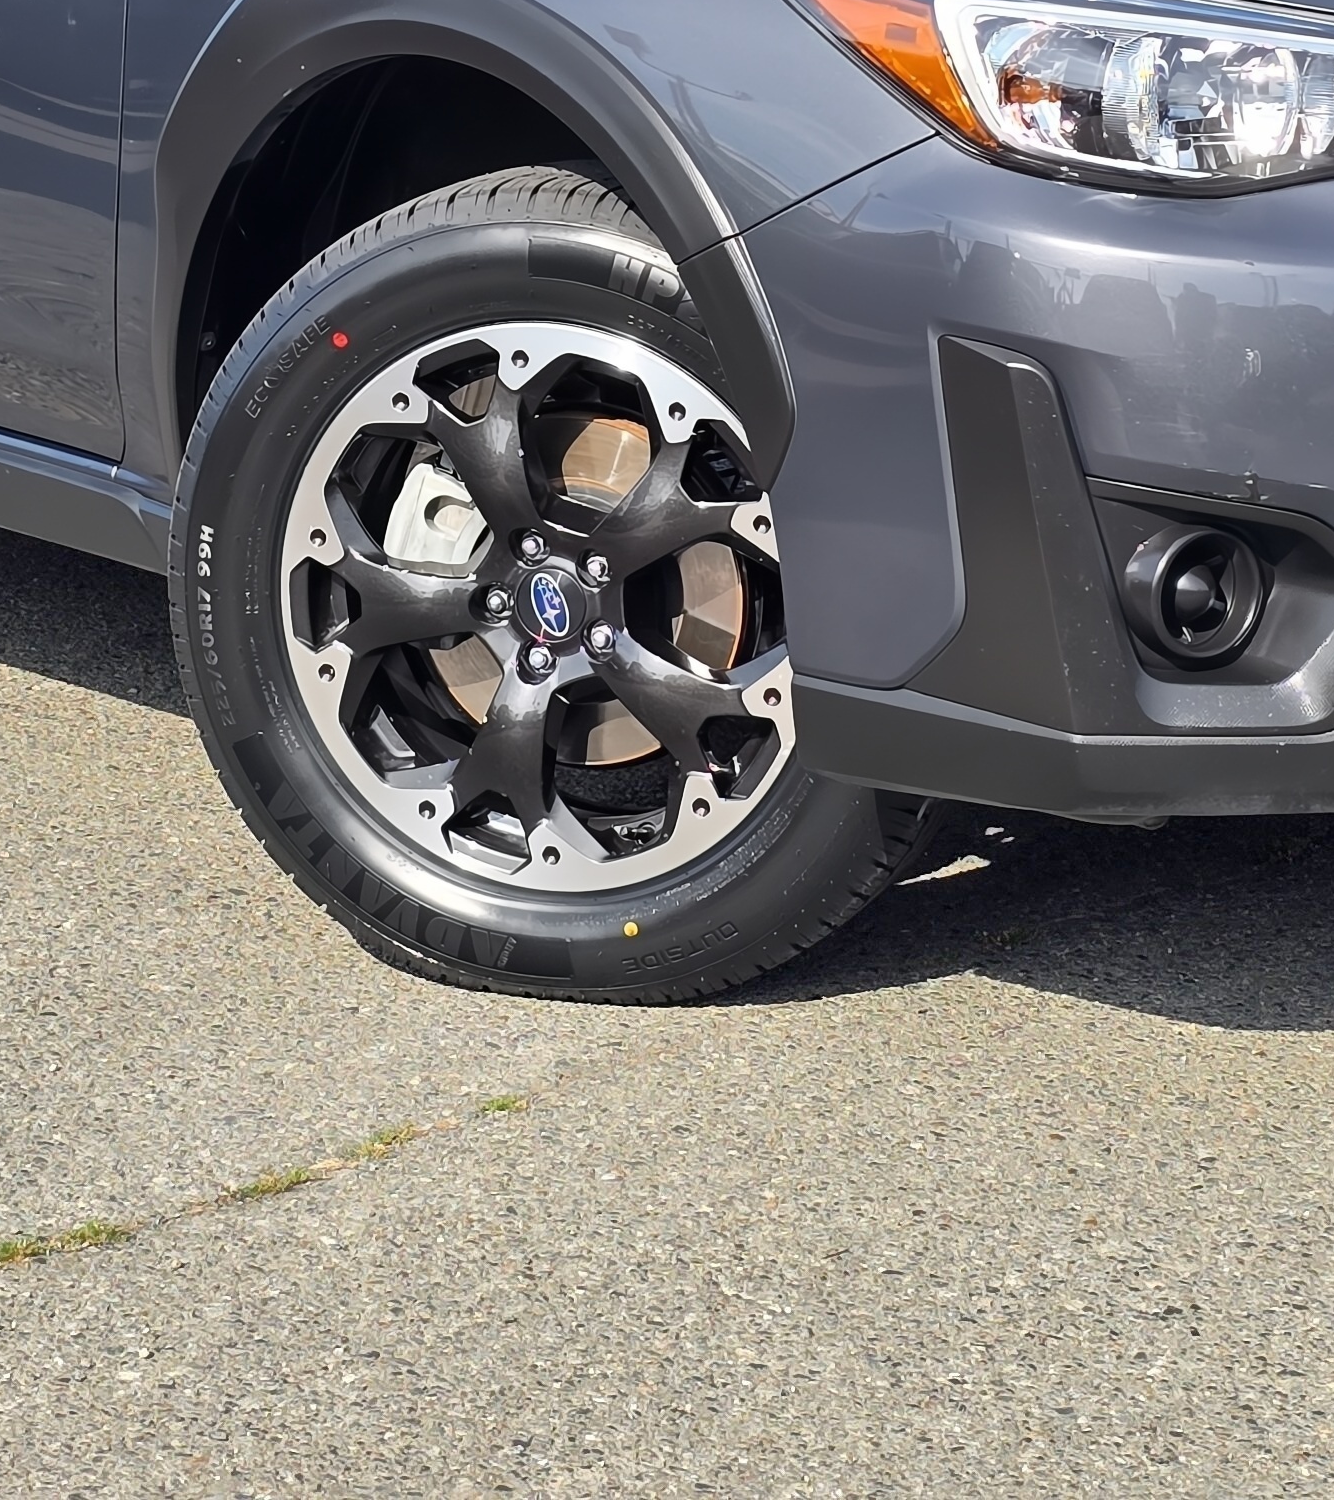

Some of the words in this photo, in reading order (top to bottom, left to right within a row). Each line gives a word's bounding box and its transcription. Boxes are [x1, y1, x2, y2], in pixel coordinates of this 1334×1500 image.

[196, 523, 216, 578] 99H
[266, 779, 511, 968] ADVANTA
[621, 920, 739, 976] OUTSIDE
